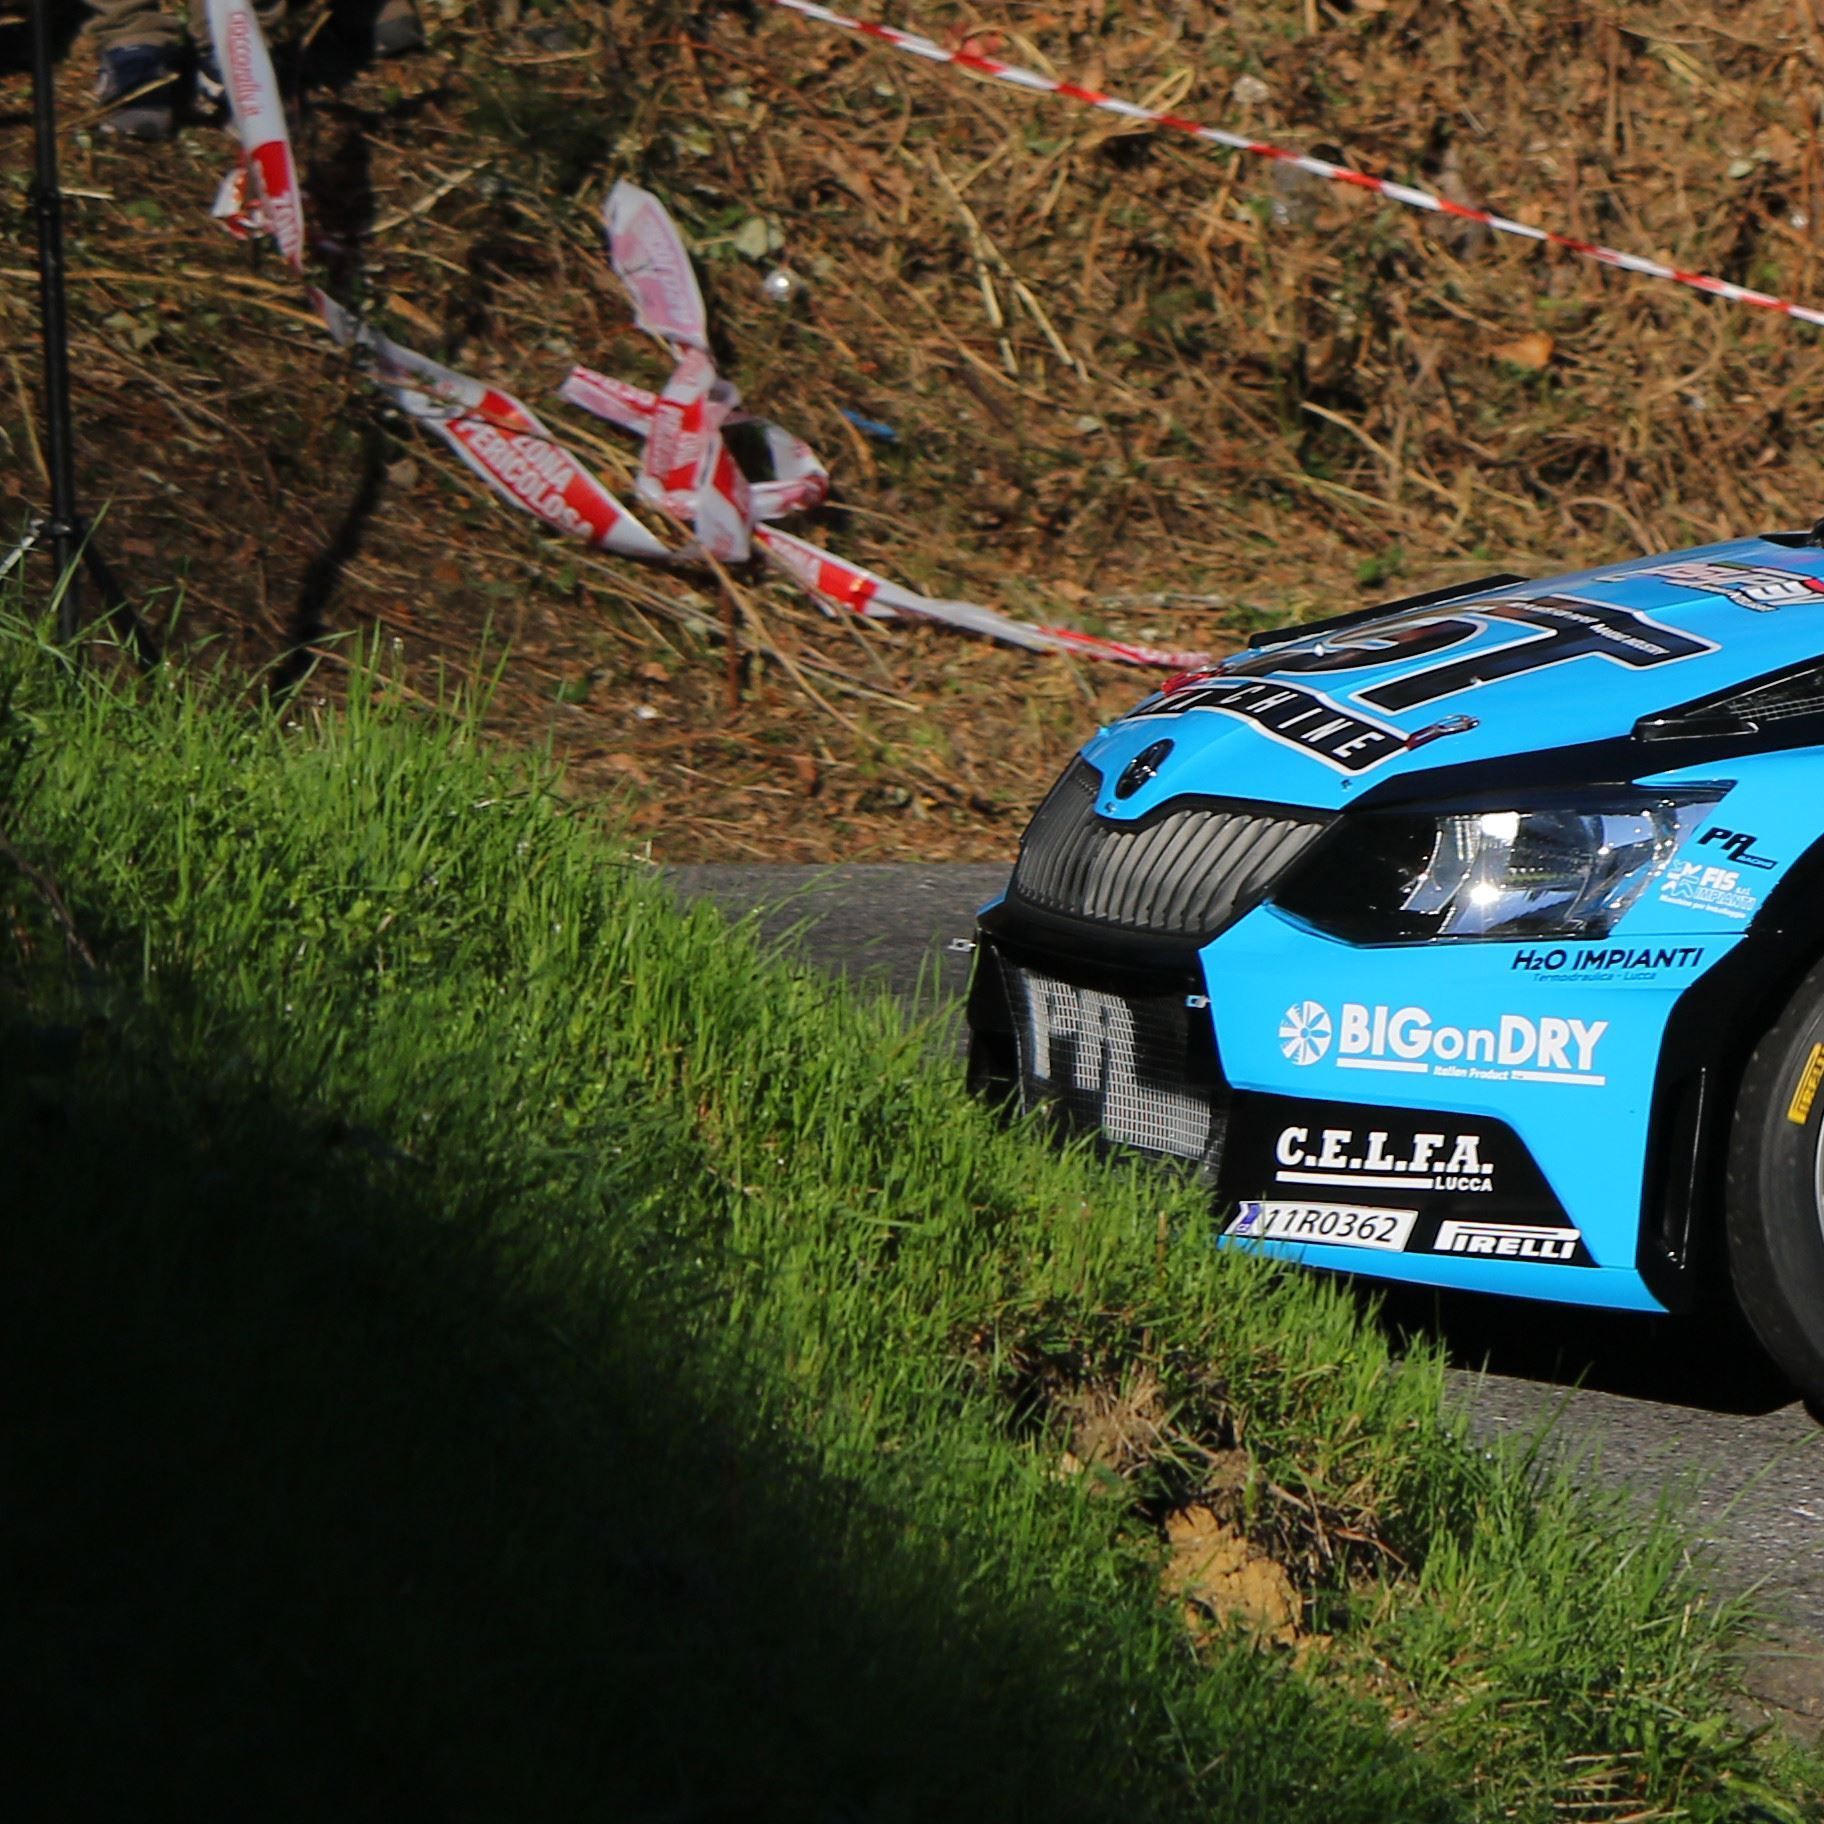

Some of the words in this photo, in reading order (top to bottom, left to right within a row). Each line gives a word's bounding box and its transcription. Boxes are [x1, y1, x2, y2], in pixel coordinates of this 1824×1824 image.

[1700, 866, 1741, 892] FIS
[1573, 947, 1705, 971] IMPIANTI
[1623, 971, 1657, 981] Lucca
[1338, 1003, 1609, 1070] BIGonDRY
[1434, 1065, 1466, 1078] Italian
[1468, 1067, 1510, 1081] Product
[1276, 1126, 1494, 1175] C.E.L.F.A.
[1435, 1176, 1493, 1192] LUCCA
[1264, 1209, 1399, 1244] 11R0362
[1433, 1222, 1580, 1260] PIRELLI
